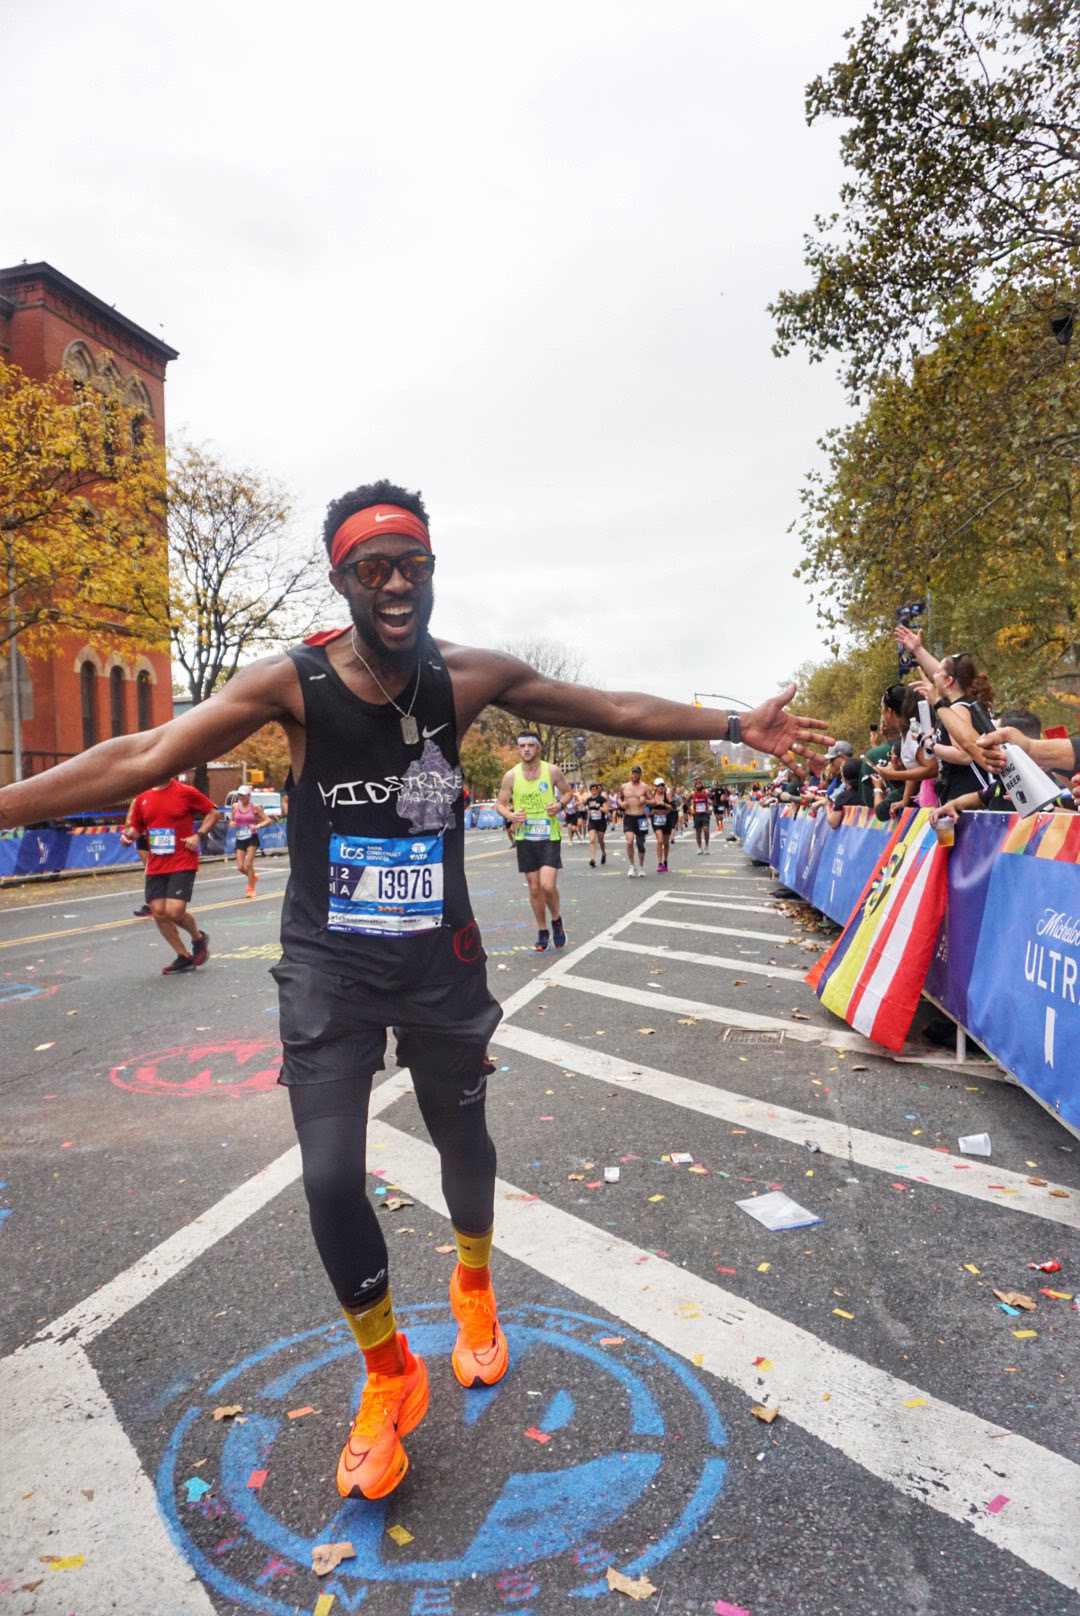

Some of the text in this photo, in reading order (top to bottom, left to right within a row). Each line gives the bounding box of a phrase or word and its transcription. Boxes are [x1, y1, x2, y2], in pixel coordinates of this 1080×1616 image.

[1000, 763, 1016, 779] RING
[1006, 774, 1022, 791] BEER
[340, 843, 365, 860] tcs
[409, 853, 428, 861] TATA
[340, 867, 350, 880] 2
[340, 884, 351, 896] A
[378, 867, 433, 900] 13976
[1036, 907, 1080, 946] Michelo
[1024, 939, 1080, 1006] ULTR
